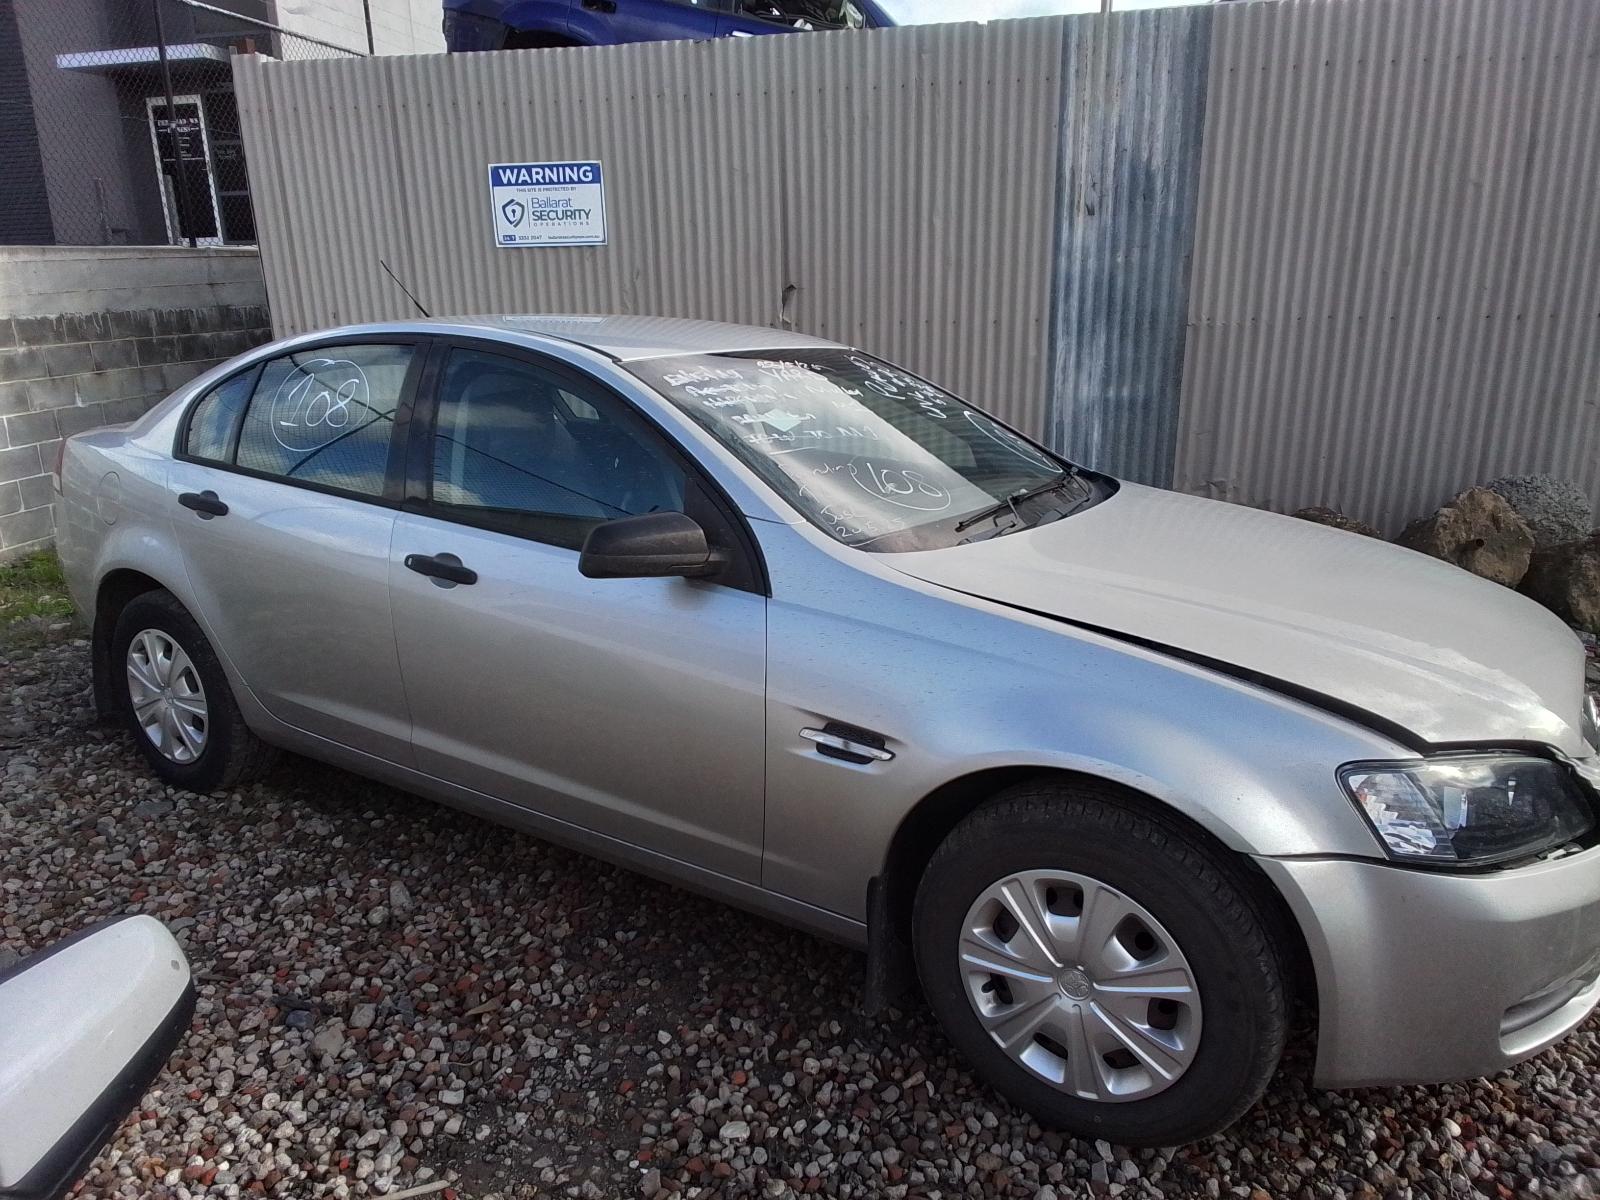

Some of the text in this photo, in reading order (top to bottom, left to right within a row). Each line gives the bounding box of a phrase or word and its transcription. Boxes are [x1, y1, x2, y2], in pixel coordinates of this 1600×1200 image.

[498, 166, 593, 184] WARNING
[531, 197, 573, 209] Ballarat
[532, 209, 592, 221] SECURITY
[280, 373, 360, 427] 108
